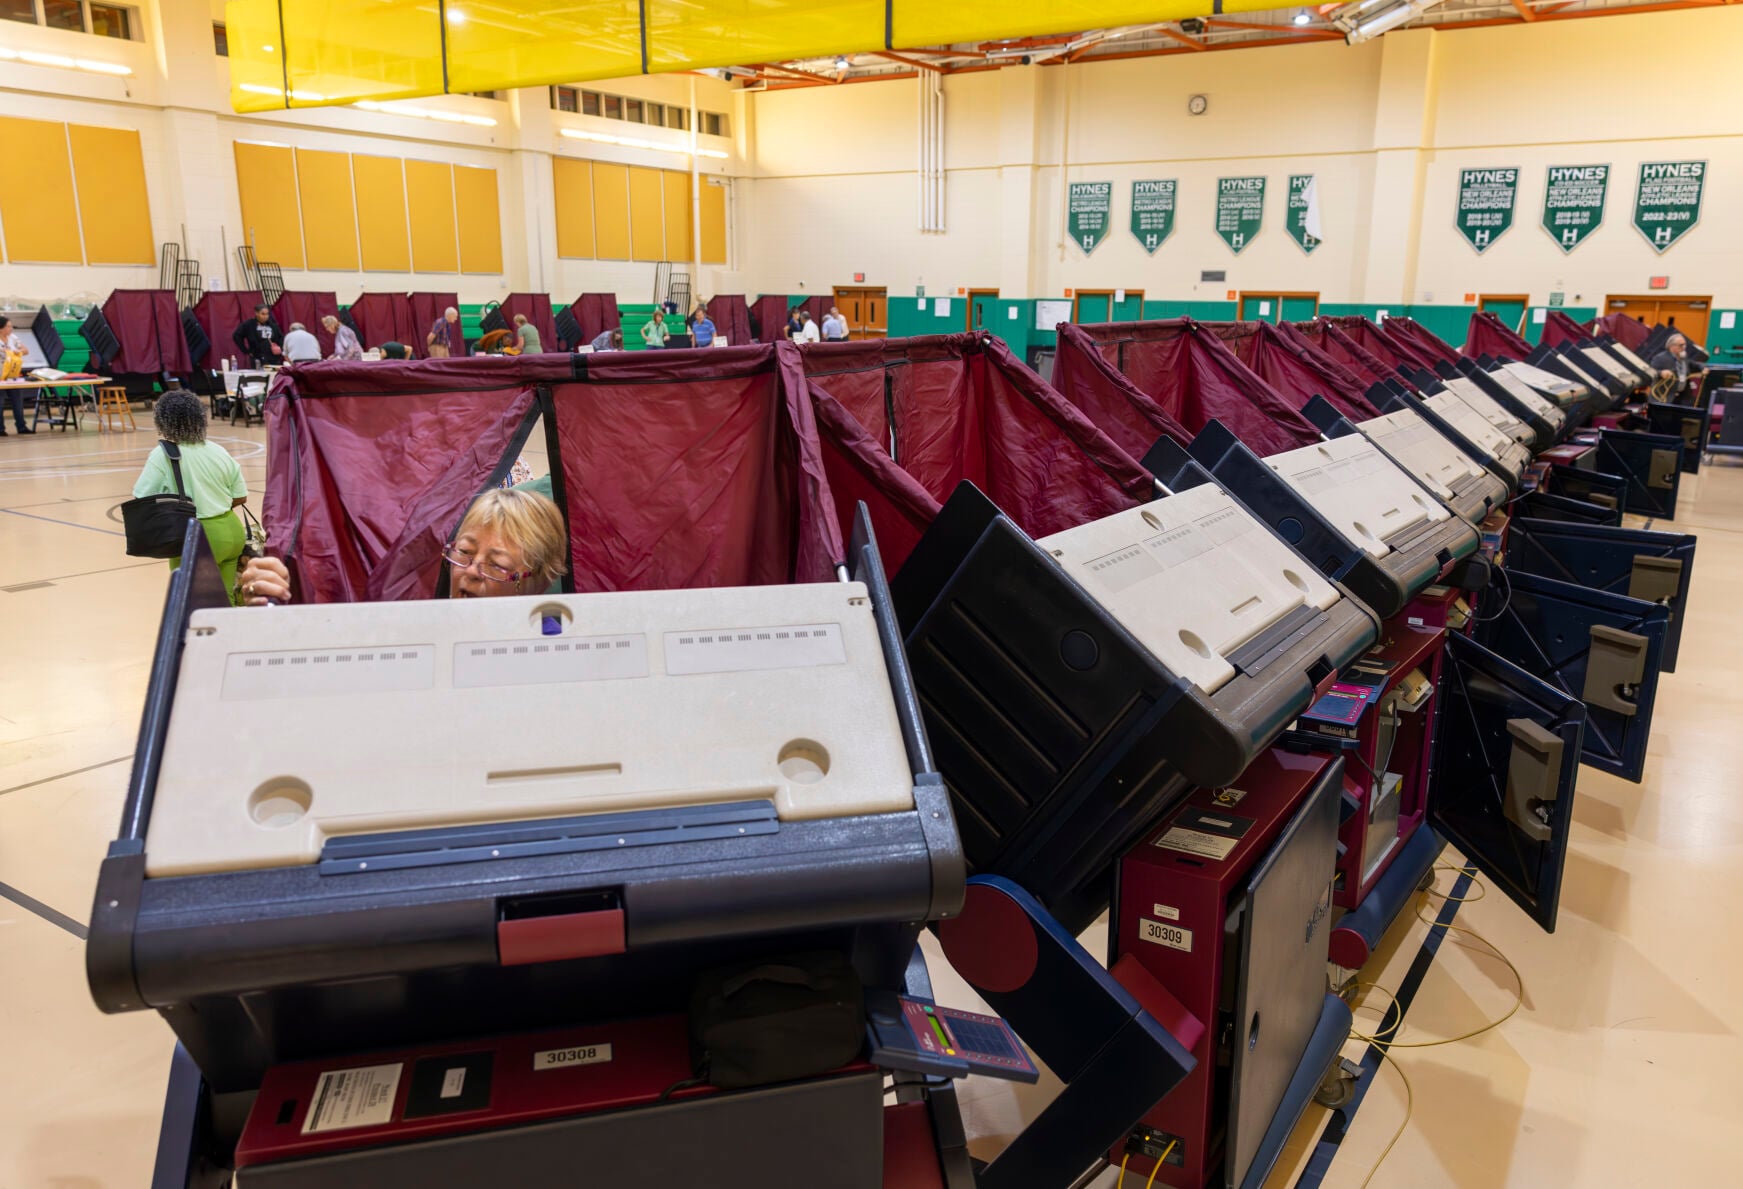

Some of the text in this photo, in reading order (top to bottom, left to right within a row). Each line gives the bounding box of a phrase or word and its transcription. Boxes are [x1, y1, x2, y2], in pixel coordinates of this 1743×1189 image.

[1464, 170, 1515, 183] HYNES
[1551, 167, 1606, 180] HYNES
[1643, 163, 1703, 178] HYNES
[1072, 184, 1109, 194] HYNES
[1135, 182, 1174, 192] HYNES
[1221, 179, 1263, 190] HYNES
[1292, 178, 1312, 188] HY
[1232, 233, 1244, 245] H
[1475, 230, 1490, 242] H
[1562, 229, 1578, 241] H
[1655, 227, 1672, 240] H
[1084, 235, 1094, 246] H
[1146, 234, 1157, 246] H
[1148, 924, 1182, 944] 30309
[547, 1048, 597, 1064] 30308
